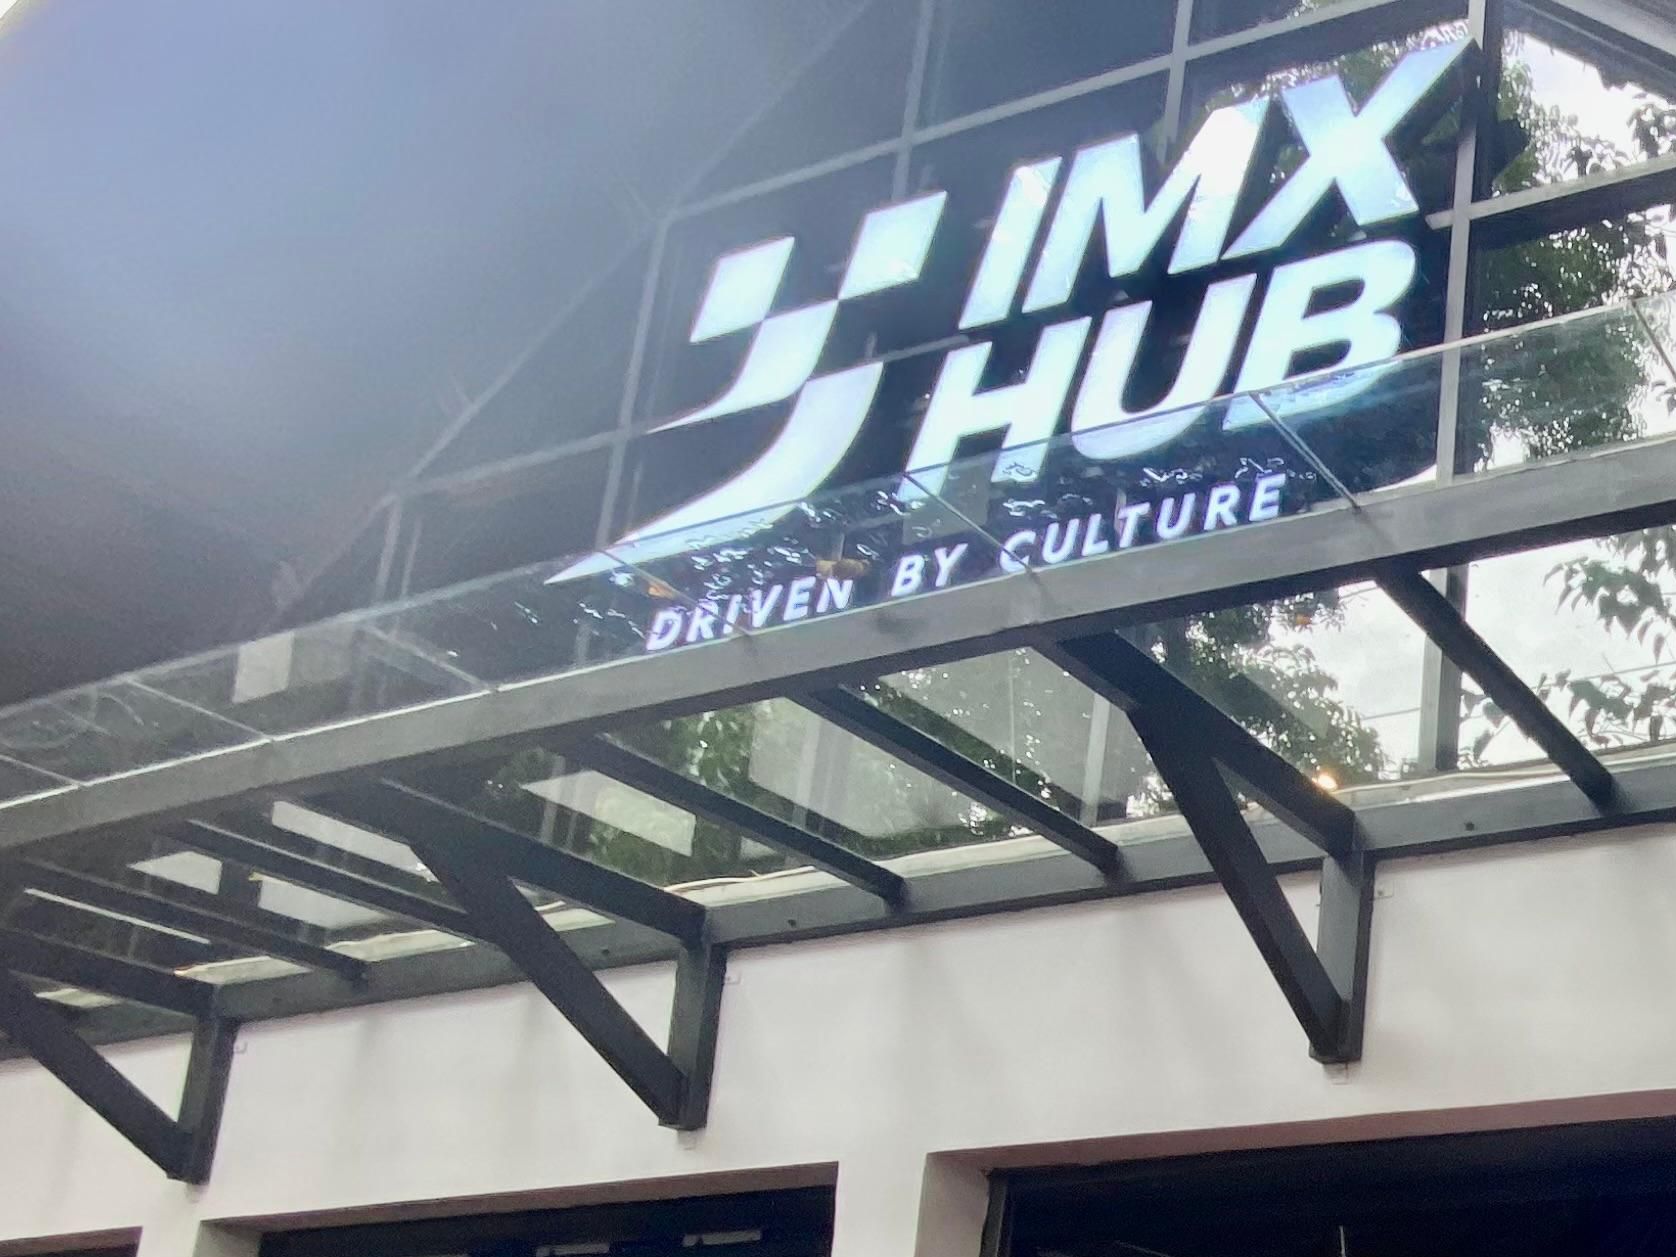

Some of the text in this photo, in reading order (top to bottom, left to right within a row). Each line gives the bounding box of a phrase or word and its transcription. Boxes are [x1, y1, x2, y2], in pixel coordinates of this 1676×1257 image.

[957, 36, 1476, 331] IMX
[897, 239, 1417, 503] HUB
[645, 473, 1287, 651] DRIVEN BY CULTURE
